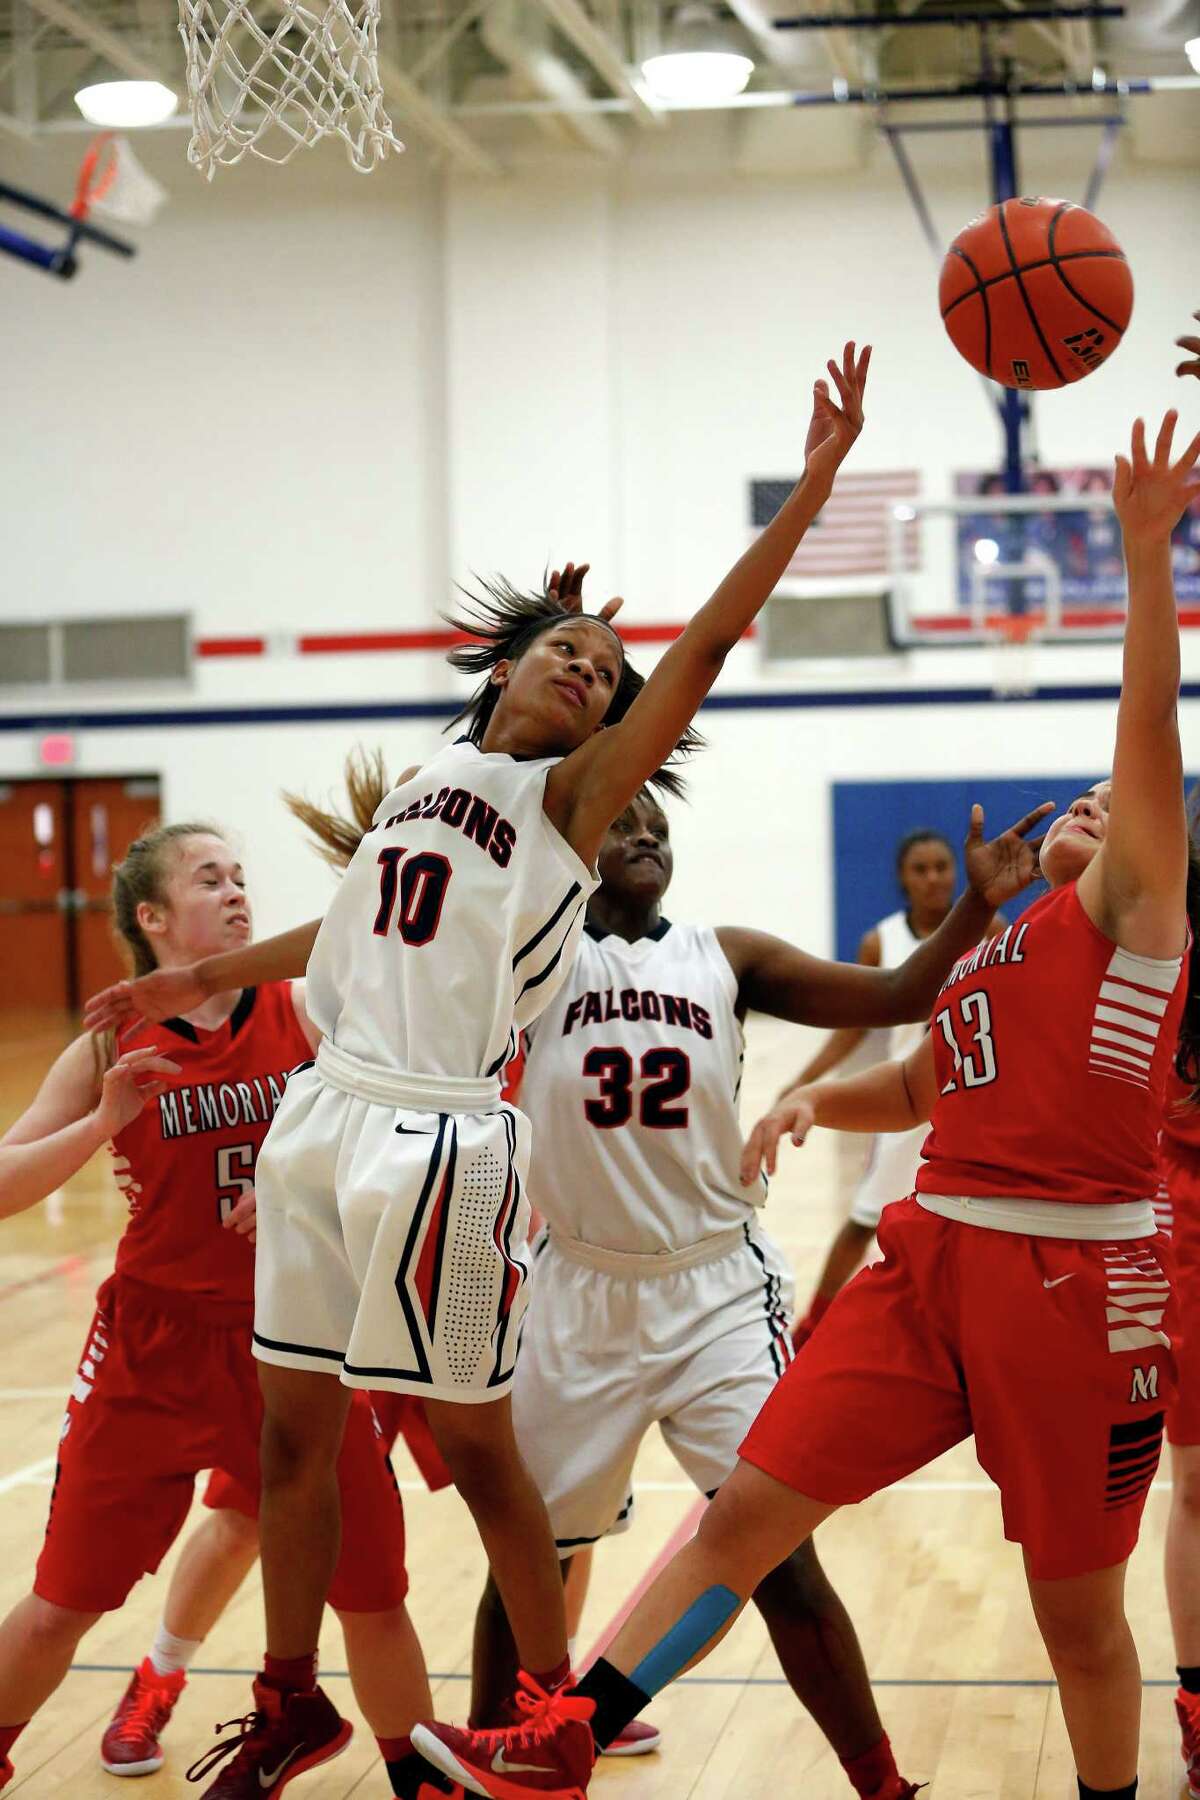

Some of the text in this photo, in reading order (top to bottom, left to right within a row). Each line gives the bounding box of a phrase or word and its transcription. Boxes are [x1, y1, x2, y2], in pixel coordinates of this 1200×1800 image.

[373, 847, 453, 947] 10
[562, 987, 713, 1040] FALCONS
[936, 990, 997, 1096] 13
[159, 1071, 288, 1139] MEMORIA
[582, 1046, 691, 1129] 32
[215, 1142, 256, 1226] 5
[1129, 1364, 1159, 1403] M
